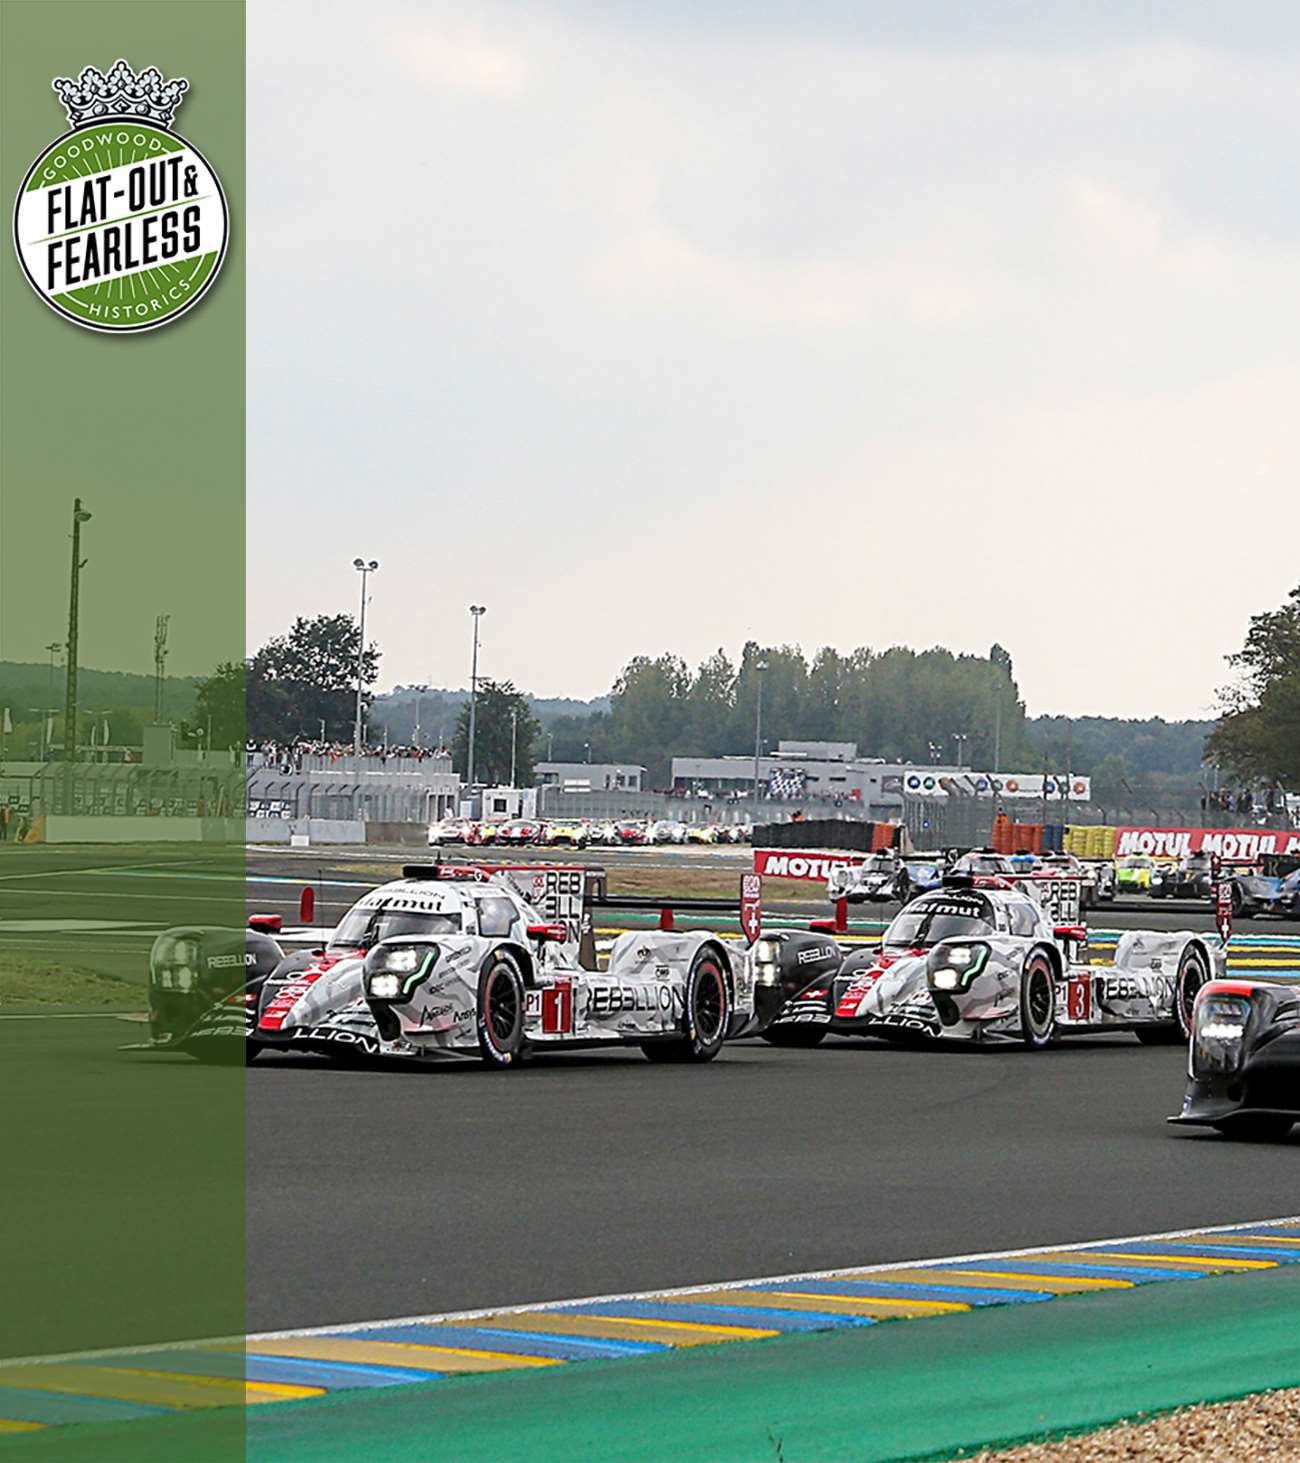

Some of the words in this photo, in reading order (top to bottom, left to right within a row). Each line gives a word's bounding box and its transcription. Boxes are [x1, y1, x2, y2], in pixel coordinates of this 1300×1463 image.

[1117, 832, 1194, 857] MOTUL
[1201, 834, 1278, 858] MOTUL
[765, 856, 847, 879] MOTU
[546, 872, 581, 894] REB
[1051, 882, 1077, 900] REB
[526, 993, 540, 1011] P1
[587, 984, 686, 1012] REBELLION
[1075, 984, 1086, 1017] 3
[554, 991, 563, 1031] 1
